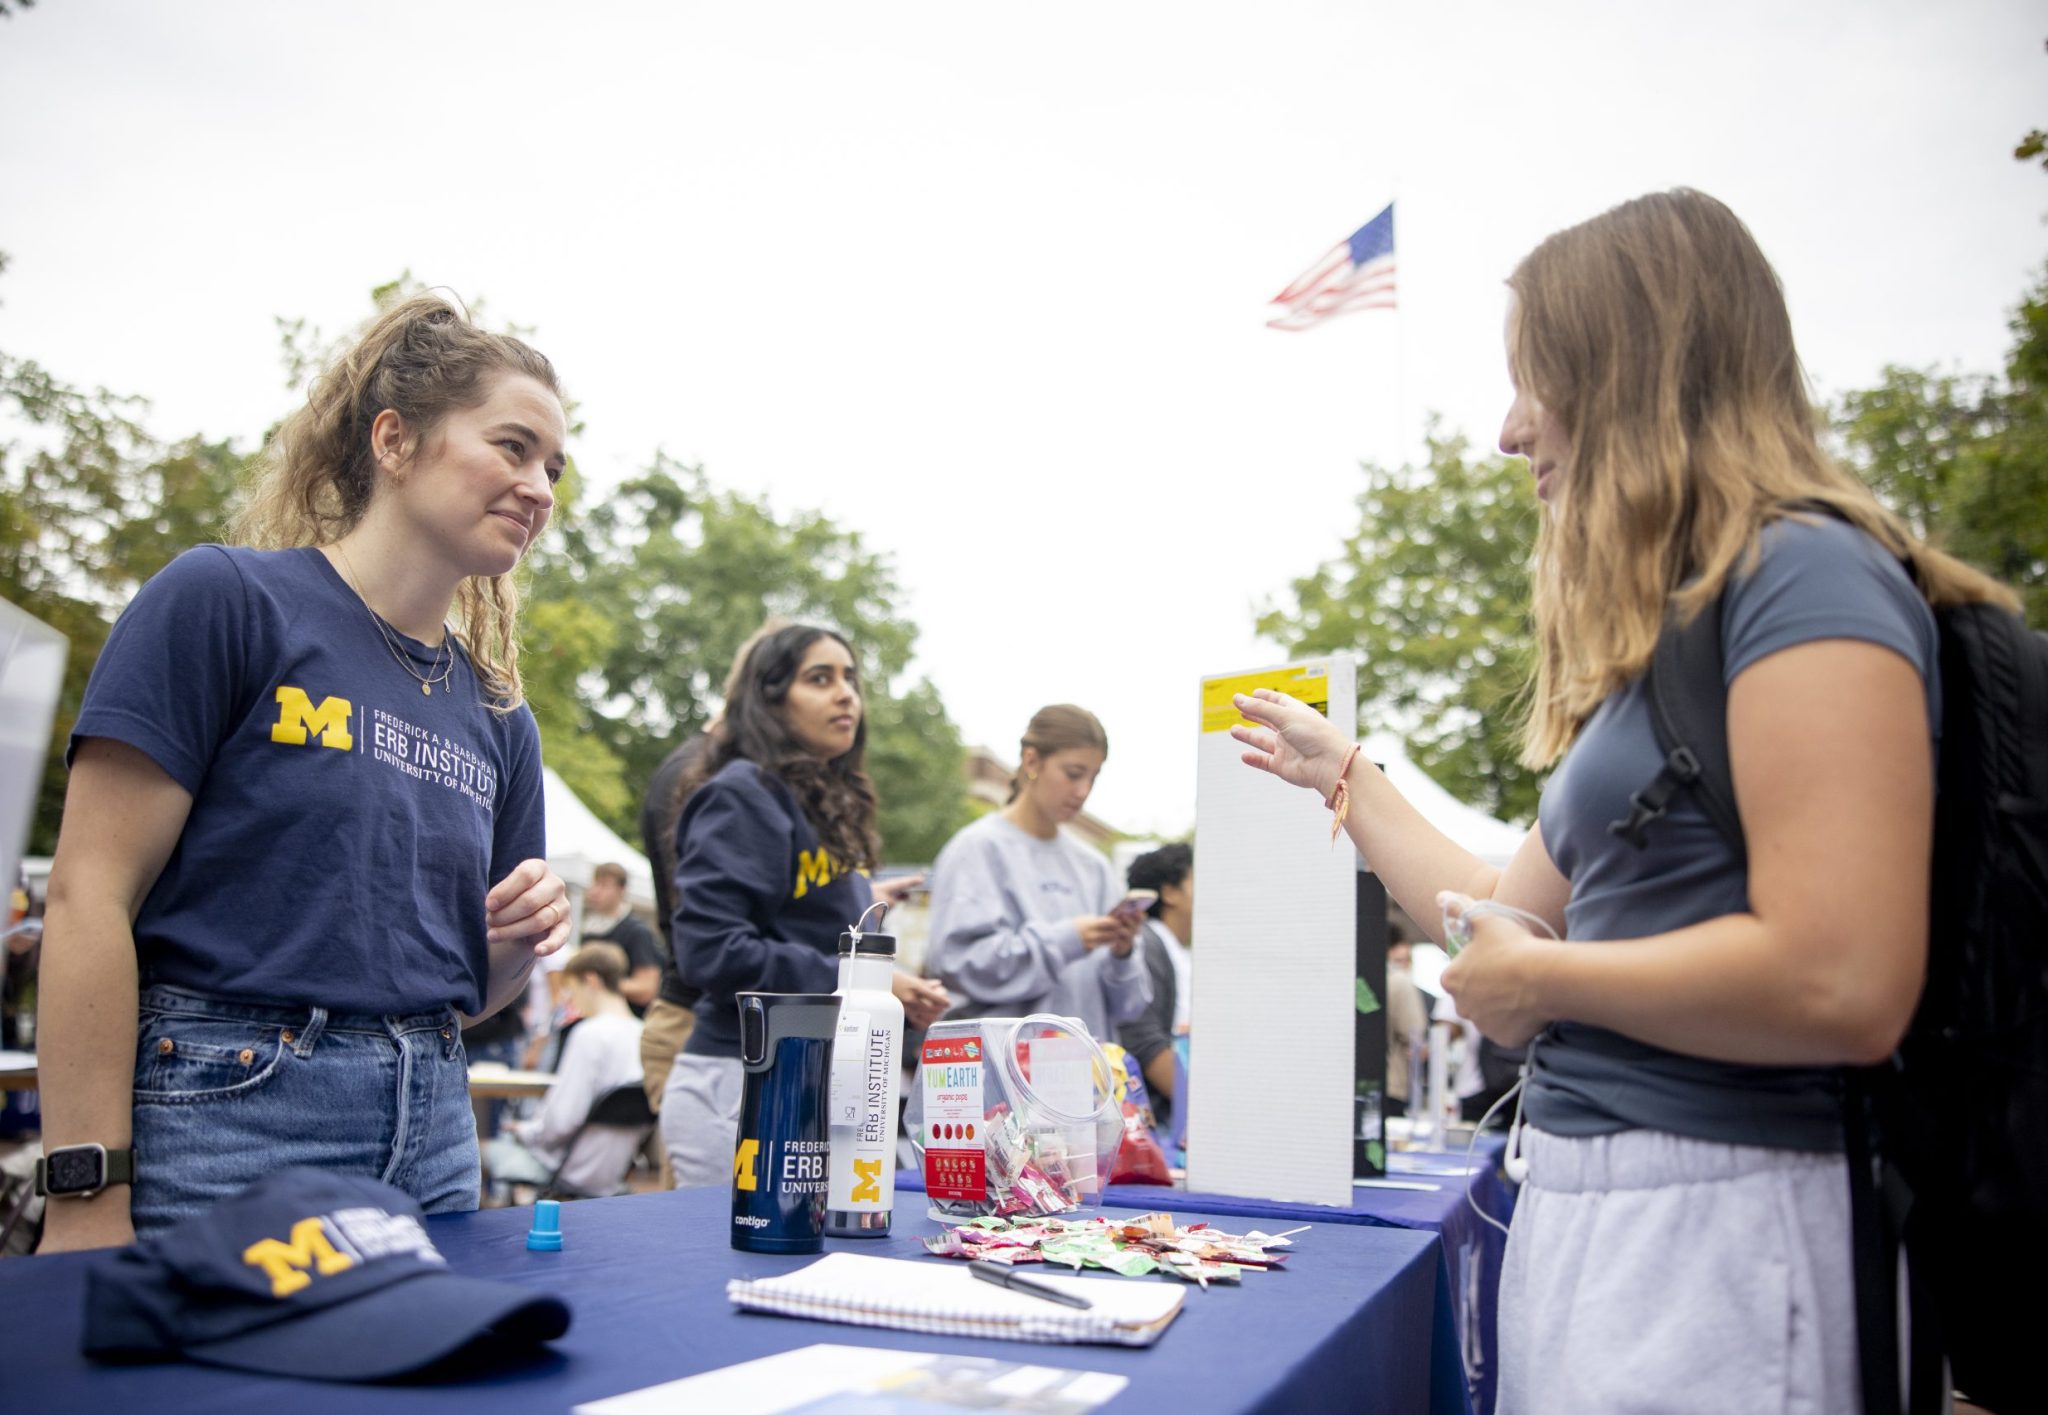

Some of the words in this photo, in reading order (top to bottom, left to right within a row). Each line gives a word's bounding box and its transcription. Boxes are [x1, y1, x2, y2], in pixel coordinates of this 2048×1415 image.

[271, 685, 353, 751] M
[374, 709, 428, 741] FREDERICK
[445, 738, 452, 750] &
[374, 722, 408, 759] ERB
[374, 747, 442, 783] UNIVERSITY
[444, 775, 458, 790] OF
[868, 1029, 884, 1108] INSTITUTE
[883, 1030, 891, 1075] MICHIGAN
[882, 1077, 889, 1088] OF
[927, 1066, 978, 1089] YUMEARTH
[865, 1113, 879, 1142] ERB
[879, 1090, 888, 1142] UNIVERSITY
[782, 1181, 829, 1194] UNIVERS
[783, 1155, 823, 1179] ERB
[850, 1158, 882, 1203] M
[735, 1215, 768, 1229] contigo
[242, 1216, 354, 1299] M
